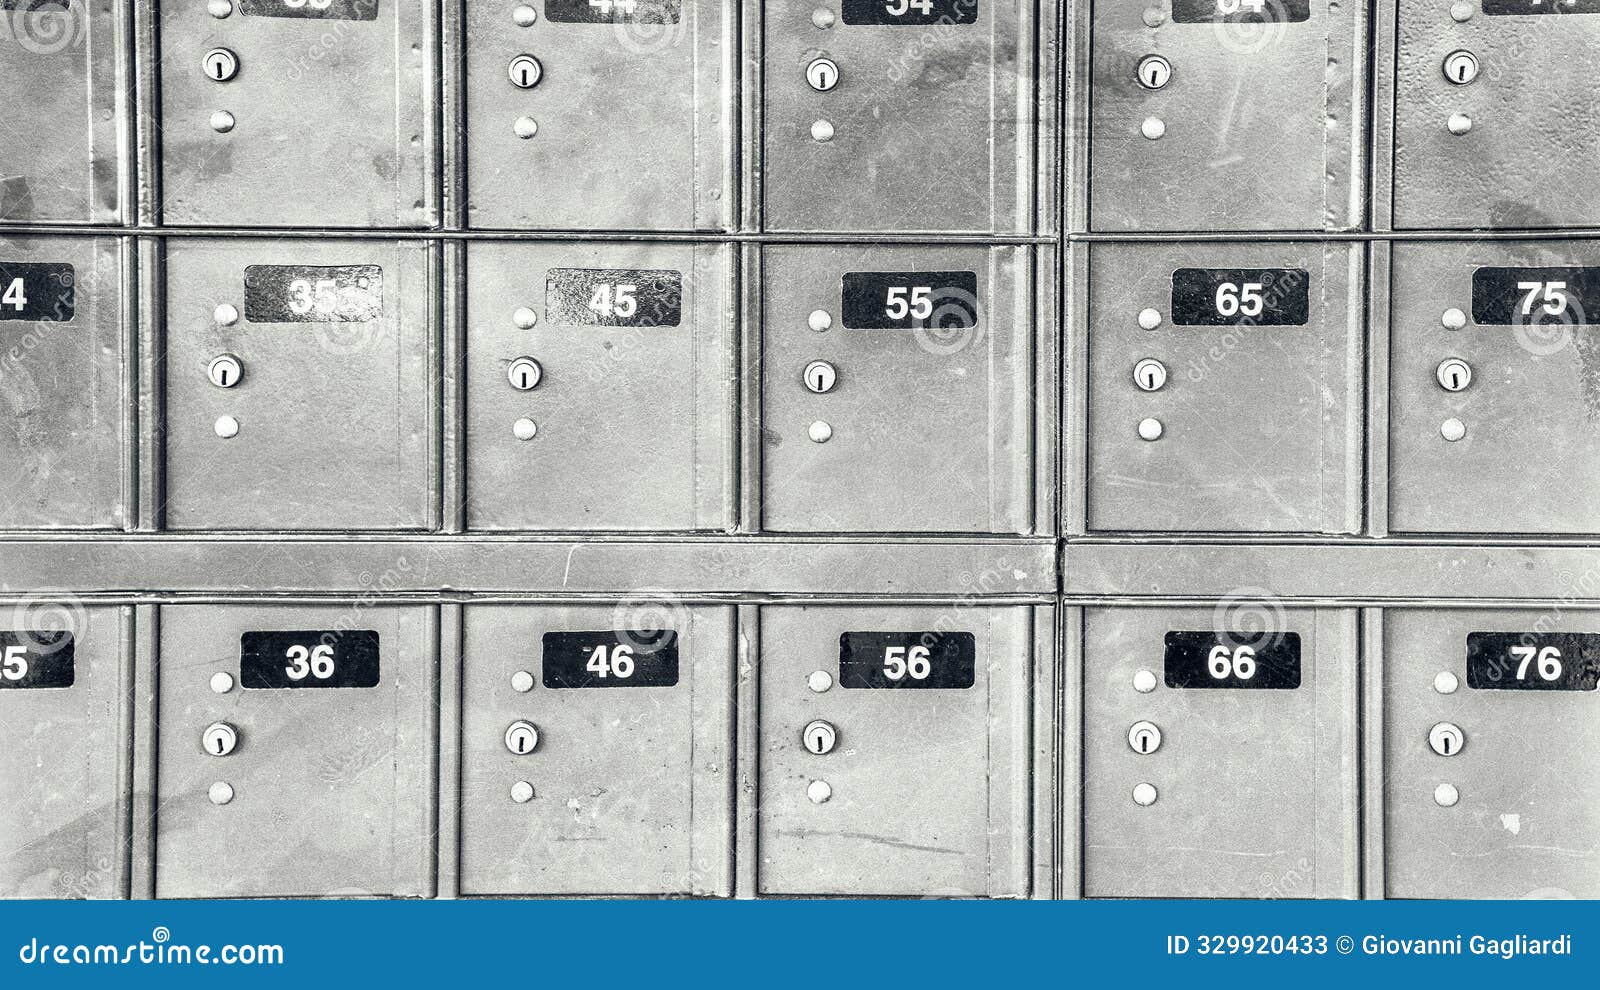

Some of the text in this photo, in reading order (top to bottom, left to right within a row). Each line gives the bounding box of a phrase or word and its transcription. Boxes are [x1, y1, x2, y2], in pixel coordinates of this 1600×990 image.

[0, 278, 27, 311] 4
[288, 279, 337, 314] 35
[589, 284, 637, 318] 45
[885, 286, 933, 320] 55
[1215, 282, 1264, 317] 65
[1517, 281, 1568, 316] 75
[0, 645, 28, 681] 5
[285, 644, 335, 680] 36
[586, 644, 636, 678] 46
[883, 645, 931, 680] 56
[1208, 645, 1256, 680] 66
[1511, 646, 1562, 681] 76
